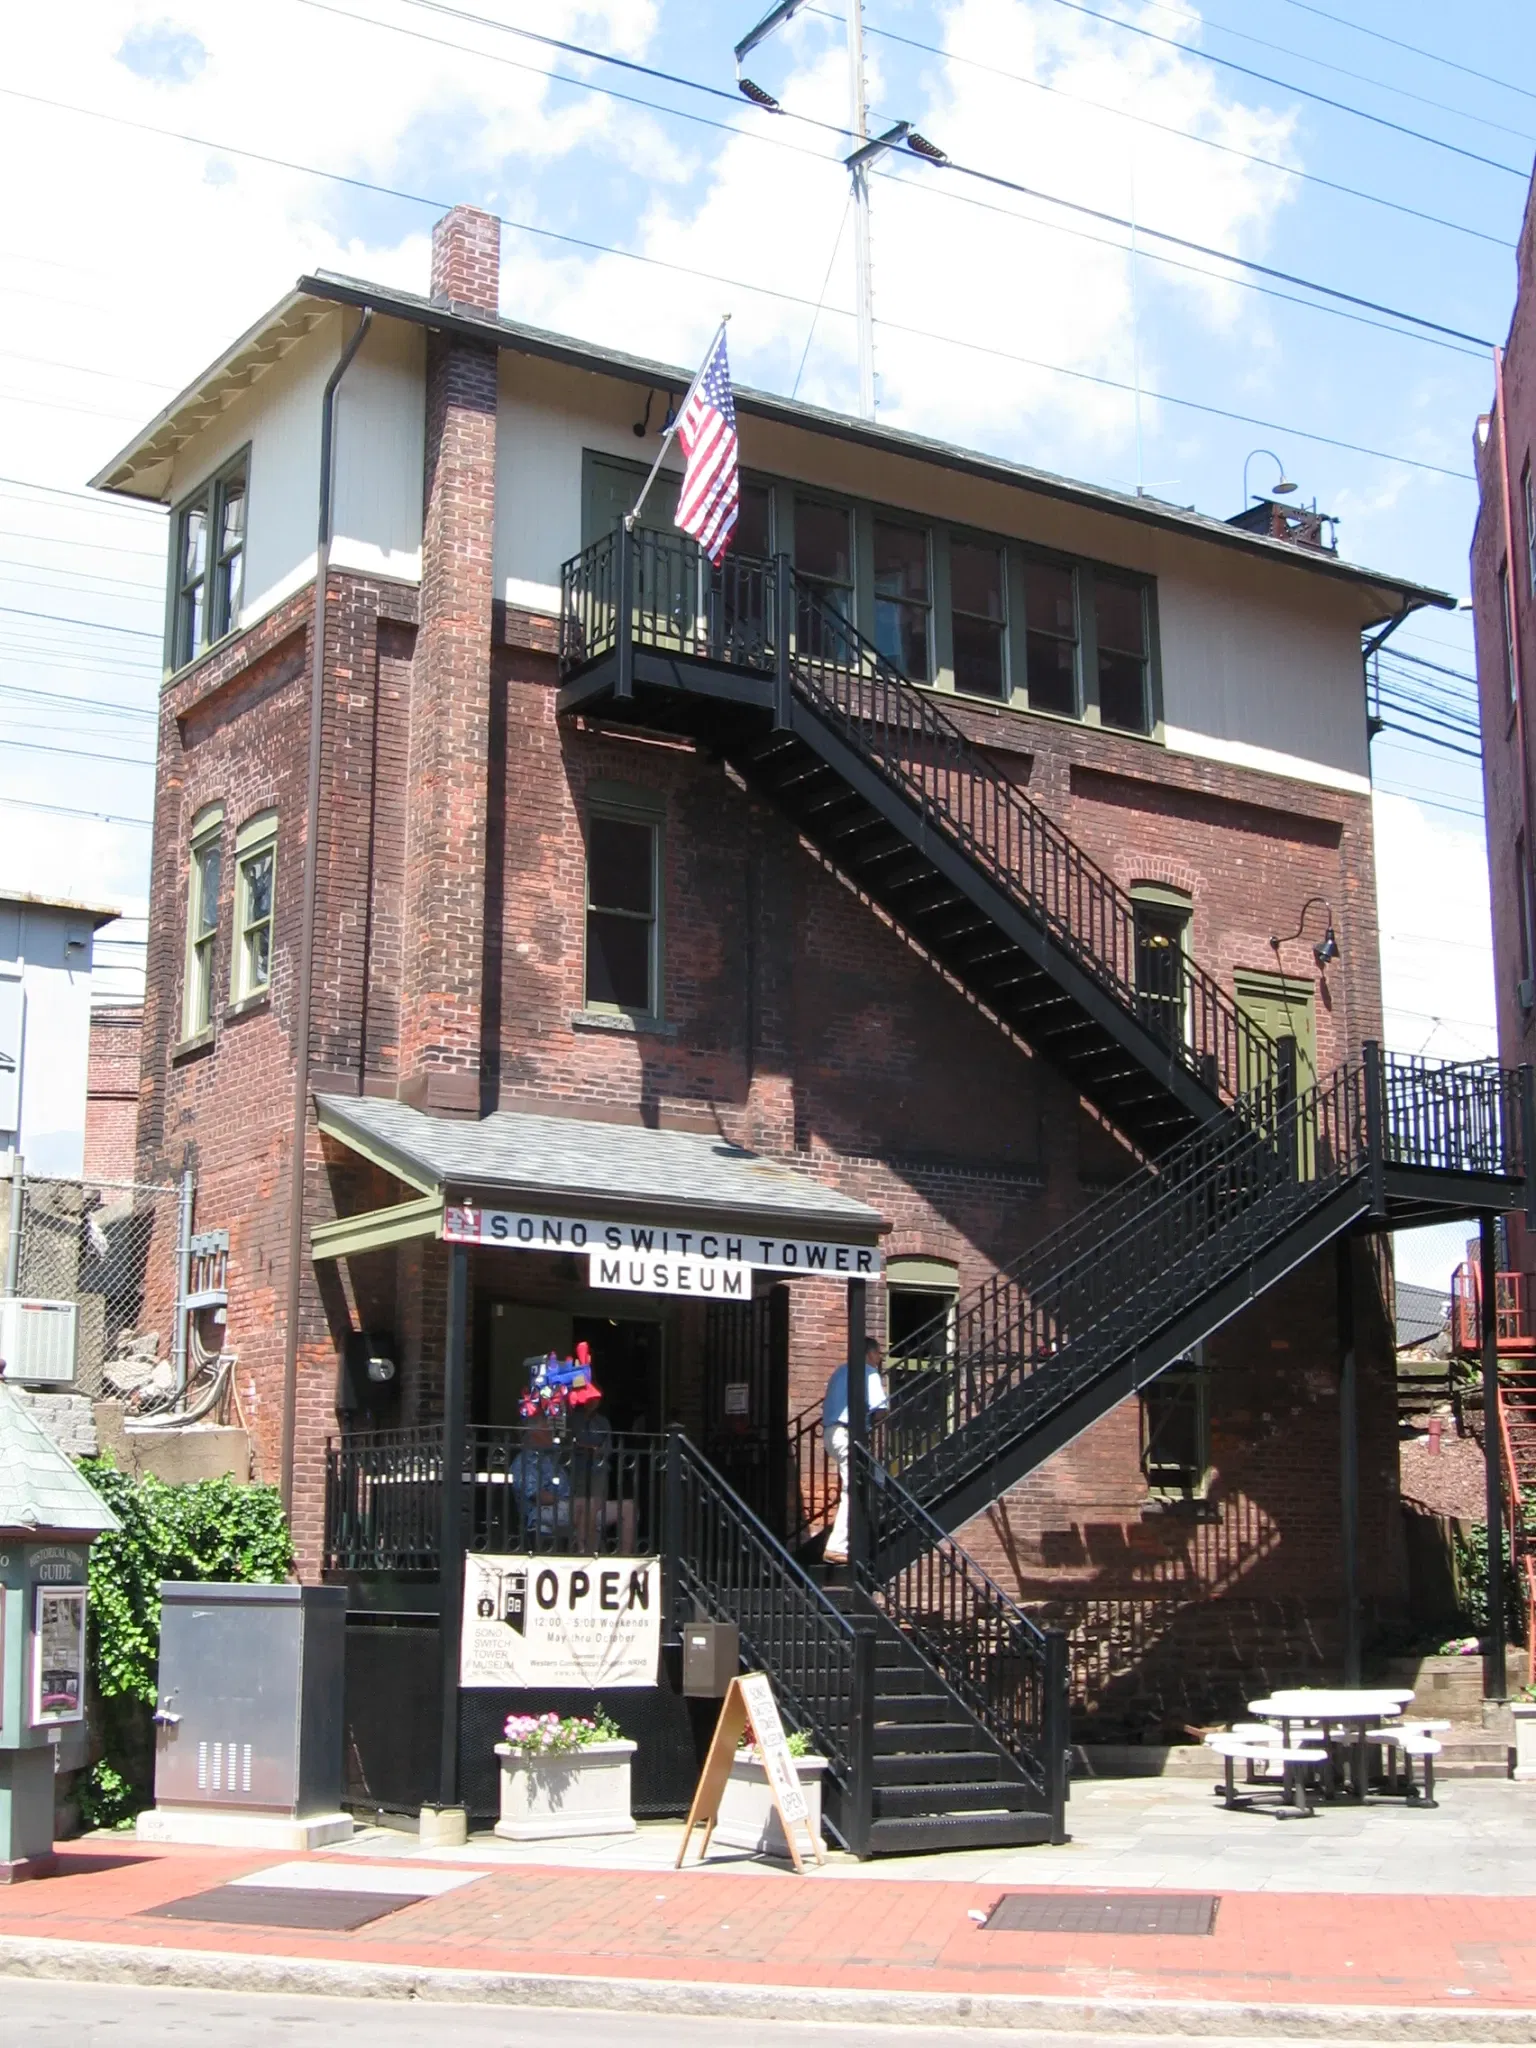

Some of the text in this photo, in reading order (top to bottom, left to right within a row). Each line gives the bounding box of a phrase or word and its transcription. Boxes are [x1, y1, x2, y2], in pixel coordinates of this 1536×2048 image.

[490, 1215, 872, 1273] SONO SWITCH TOWER
[600, 1259, 742, 1294] MUSEUM
[40, 1563, 72, 1580] GUIDE
[535, 1569, 649, 1611] OPEN
[534, 1617, 561, 1627] 12:00
[573, 1618, 595, 1628] 5:00
[475, 1628, 503, 1637] SONO
[547, 1632, 567, 1643] May
[474, 1639, 511, 1648] SWITCH
[473, 1650, 508, 1659] TOWER
[472, 1660, 514, 1669] MUSEUM
